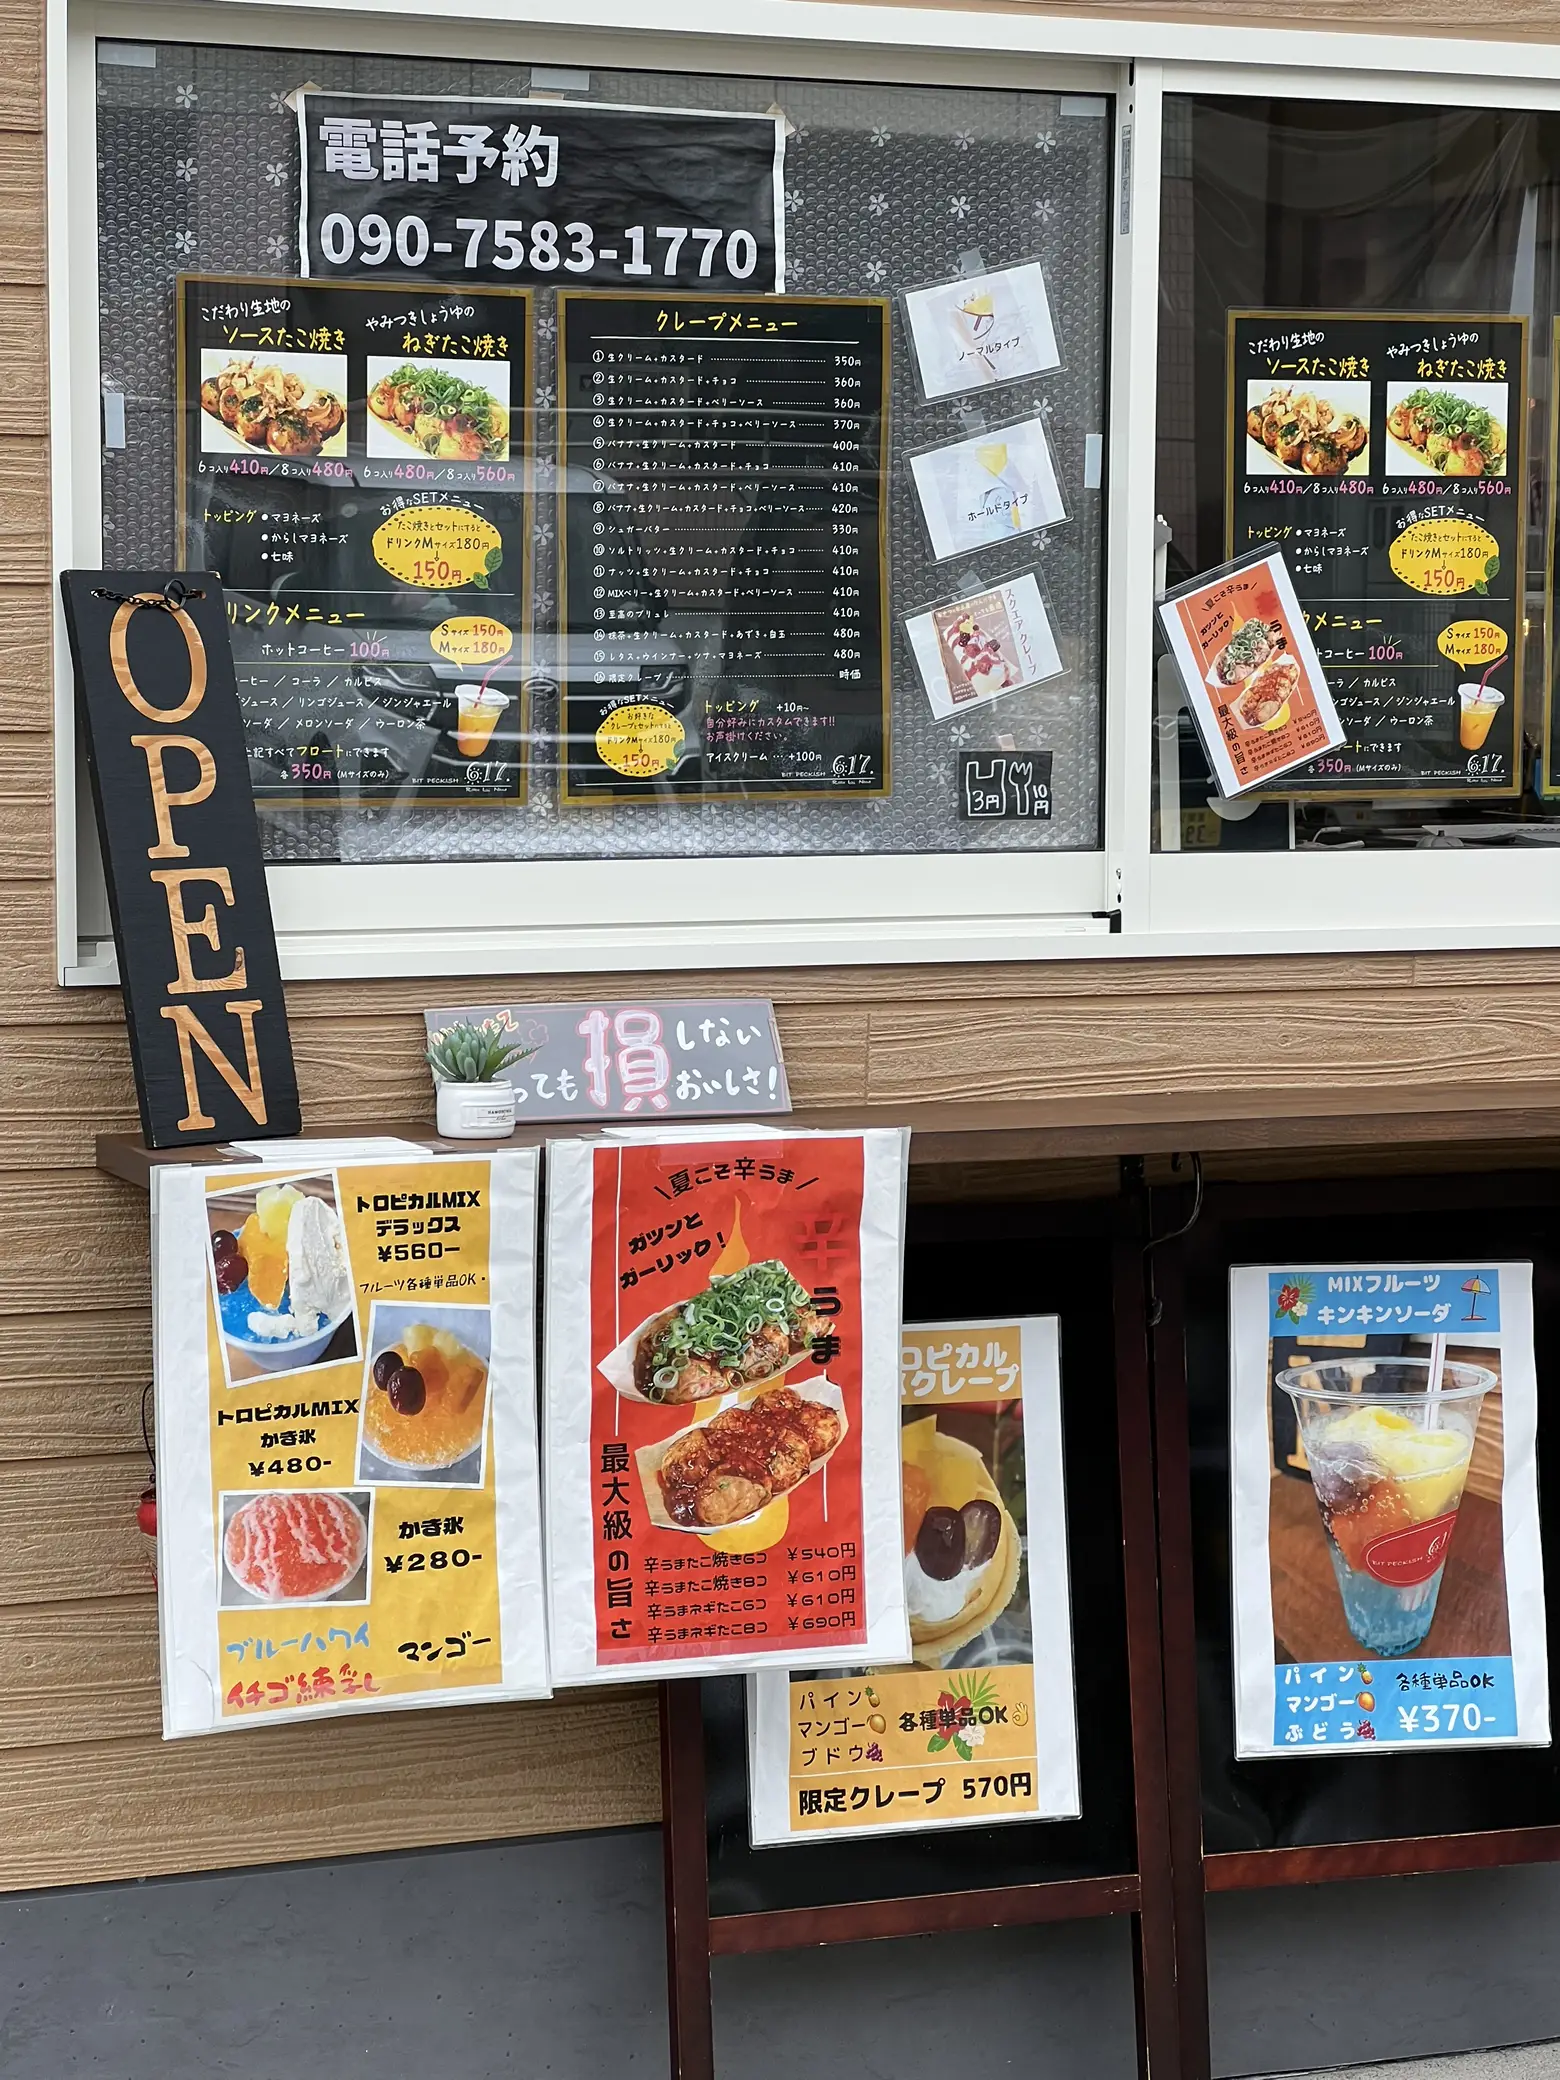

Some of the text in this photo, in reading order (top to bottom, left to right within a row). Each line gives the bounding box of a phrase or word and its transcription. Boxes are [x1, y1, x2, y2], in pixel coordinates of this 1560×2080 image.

[318, 117, 559, 187] 電話予約
[320, 212, 757, 279] 090-7583-1770
[201, 297, 291, 321] こだわり生地の
[365, 305, 475, 332] やみつきしょうゆの
[656, 310, 798, 332] クレープメニュー
[222, 325, 346, 351] ソースたこ焼き
[402, 333, 509, 358] ねぎたこ焼き
[1248, 329, 1325, 354] こだわり生地の
[1386, 332, 1479, 359] やみつきしょうゆの
[958, 336, 1021, 361] ノーマルタイプ
[834, 356, 861, 367] 350円
[1266, 354, 1371, 378] ソースたこ焼き
[1417, 358, 1508, 380] ねぎたこ焼き
[834, 377, 861, 388] 360円
[834, 398, 861, 409] 360円
[833, 419, 860, 430] 370円
[833, 440, 860, 451] 400円
[832, 461, 859, 472] 410円
[832, 482, 859, 493] 410円
[380, 492, 485, 516] お得なSETメニュー
[832, 503, 859, 514] 420円
[967, 493, 1029, 522] ホールドタイプ
[203, 510, 257, 524] トッピング
[271, 512, 322, 524] マヨネーズ
[397, 521, 481, 532] たこ焼きとセットにすると
[1396, 505, 1485, 529] お得なSETメニュー
[271, 533, 349, 545] からしマヨネーズ
[832, 524, 859, 535] 330円
[1247, 525, 1293, 539] トッピング
[1303, 527, 1347, 538] マヨネーズ
[271, 552, 294, 563] 七味
[832, 545, 859, 556] 410円
[1303, 546, 1369, 557] からしマヨネーズ
[413, 561, 462, 580] 150円
[832, 566, 859, 577] 410円
[1303, 563, 1323, 574] 七味
[1423, 569, 1465, 587] 150円
[832, 587, 860, 598] 410円
[832, 607, 860, 618] 410円
[473, 624, 504, 636] 150円
[833, 628, 860, 639] 480円
[1473, 627, 1500, 639] 150円
[261, 641, 390, 657] ホットコーヒー 100円
[473, 641, 505, 653] 180円
[833, 649, 861, 660] 480円
[1368, 645, 1403, 661] 100円
[1474, 643, 1501, 655] 180円
[292, 676, 382, 687] コーラ カルピス
[839, 669, 862, 681] 時価
[1363, 677, 1397, 688] カルピス
[299, 698, 452, 708] リンゴジュース ジンジャエール
[705, 699, 760, 713] トッピング
[1396, 696, 1456, 707] ジンジャエール
[295, 717, 426, 730] メロンソーダ ウーロン茶
[1389, 715, 1434, 726] ウーロン茶
[622, 753, 660, 767] 150円
[706, 752, 768, 762] アイスクリーム
[972, 790, 1000, 811] 3円
[109, 592, 268, 1132] OPEN
[577, 1007, 671, 1112] 損
[676, 1017, 763, 1051] しない
[675, 1066, 778, 1102] おいしさ!
[356, 1190, 481, 1213] トロピカルMIX
[376, 1215, 461, 1238] デラックス
[627, 1211, 705, 1256] ガツンと
[619, 1231, 727, 1290] ガーリック!
[1328, 1274, 1441, 1294] MIXフルーツ
[1317, 1302, 1452, 1325] キンキンソーダ
[218, 1398, 360, 1427] トロピカルMIX
[260, 1428, 317, 1449] かき氷
[398, 1515, 465, 1540] かき氷
[600, 1442, 634, 1640] 最大級の旨さ
[787, 1541, 856, 1561] ¥540円
[644, 1565, 856, 1597] 辛うまたこ焼き8コ ¥610円
[787, 1588, 856, 1607] ¥610円
[647, 1611, 856, 1643] 辛うまネギたこ8コ ¥690円
[226, 1621, 371, 1664] ブルーハワイ
[397, 1630, 492, 1663] マンゴー
[226, 1662, 382, 1708] イチゴ練乳
[1284, 1665, 1495, 1692] パイン 各種単品OK
[799, 1690, 863, 1711] パイン
[1286, 1693, 1355, 1714] マンゴー
[798, 1704, 1009, 1739] マンゴー 各種単品OK
[1284, 1720, 1356, 1743] ぶどう
[802, 1744, 865, 1767] ブドウ
[798, 1771, 1032, 1816] 限定クレープ 570円
